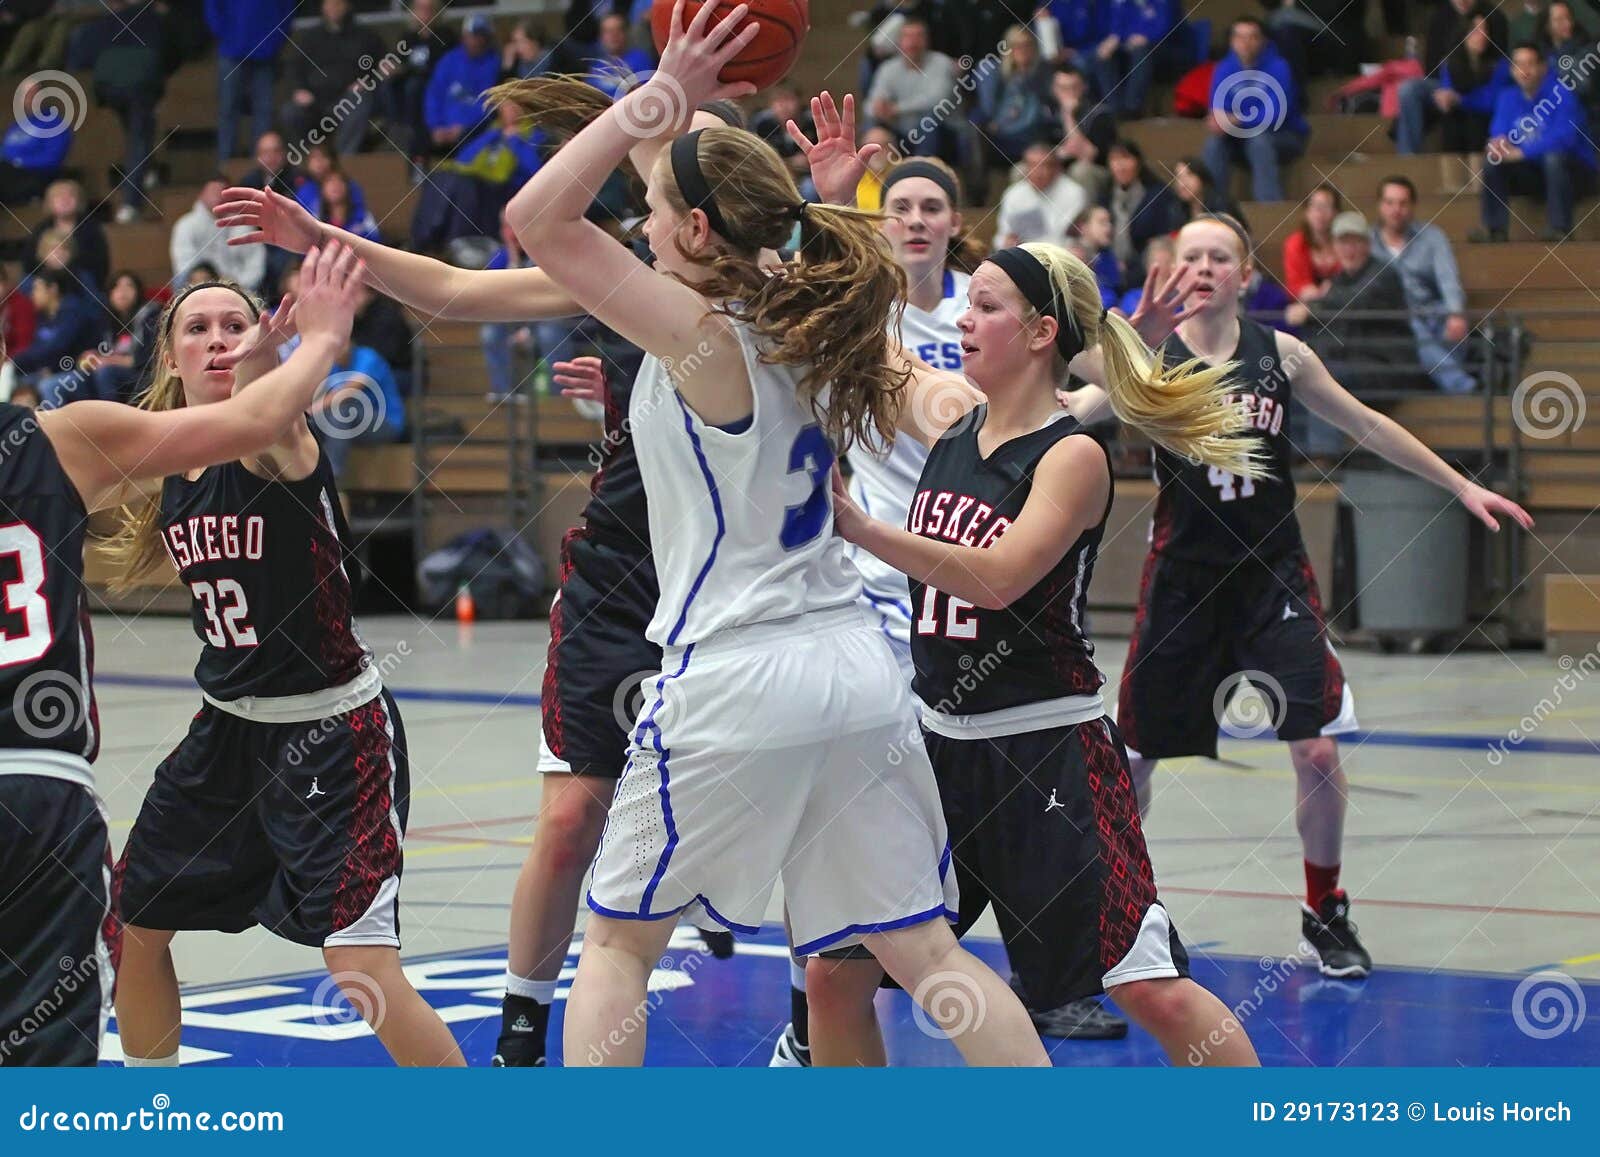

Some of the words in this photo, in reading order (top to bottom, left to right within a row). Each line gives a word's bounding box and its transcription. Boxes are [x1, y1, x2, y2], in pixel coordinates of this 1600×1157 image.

[916, 342, 963, 369] ES
[779, 421, 836, 552] 3
[160, 514, 265, 575] SKEGO
[905, 488, 1013, 549] USKEG
[0, 519, 55, 668] 3
[189, 577, 259, 649] 32
[917, 583, 979, 639] 12
